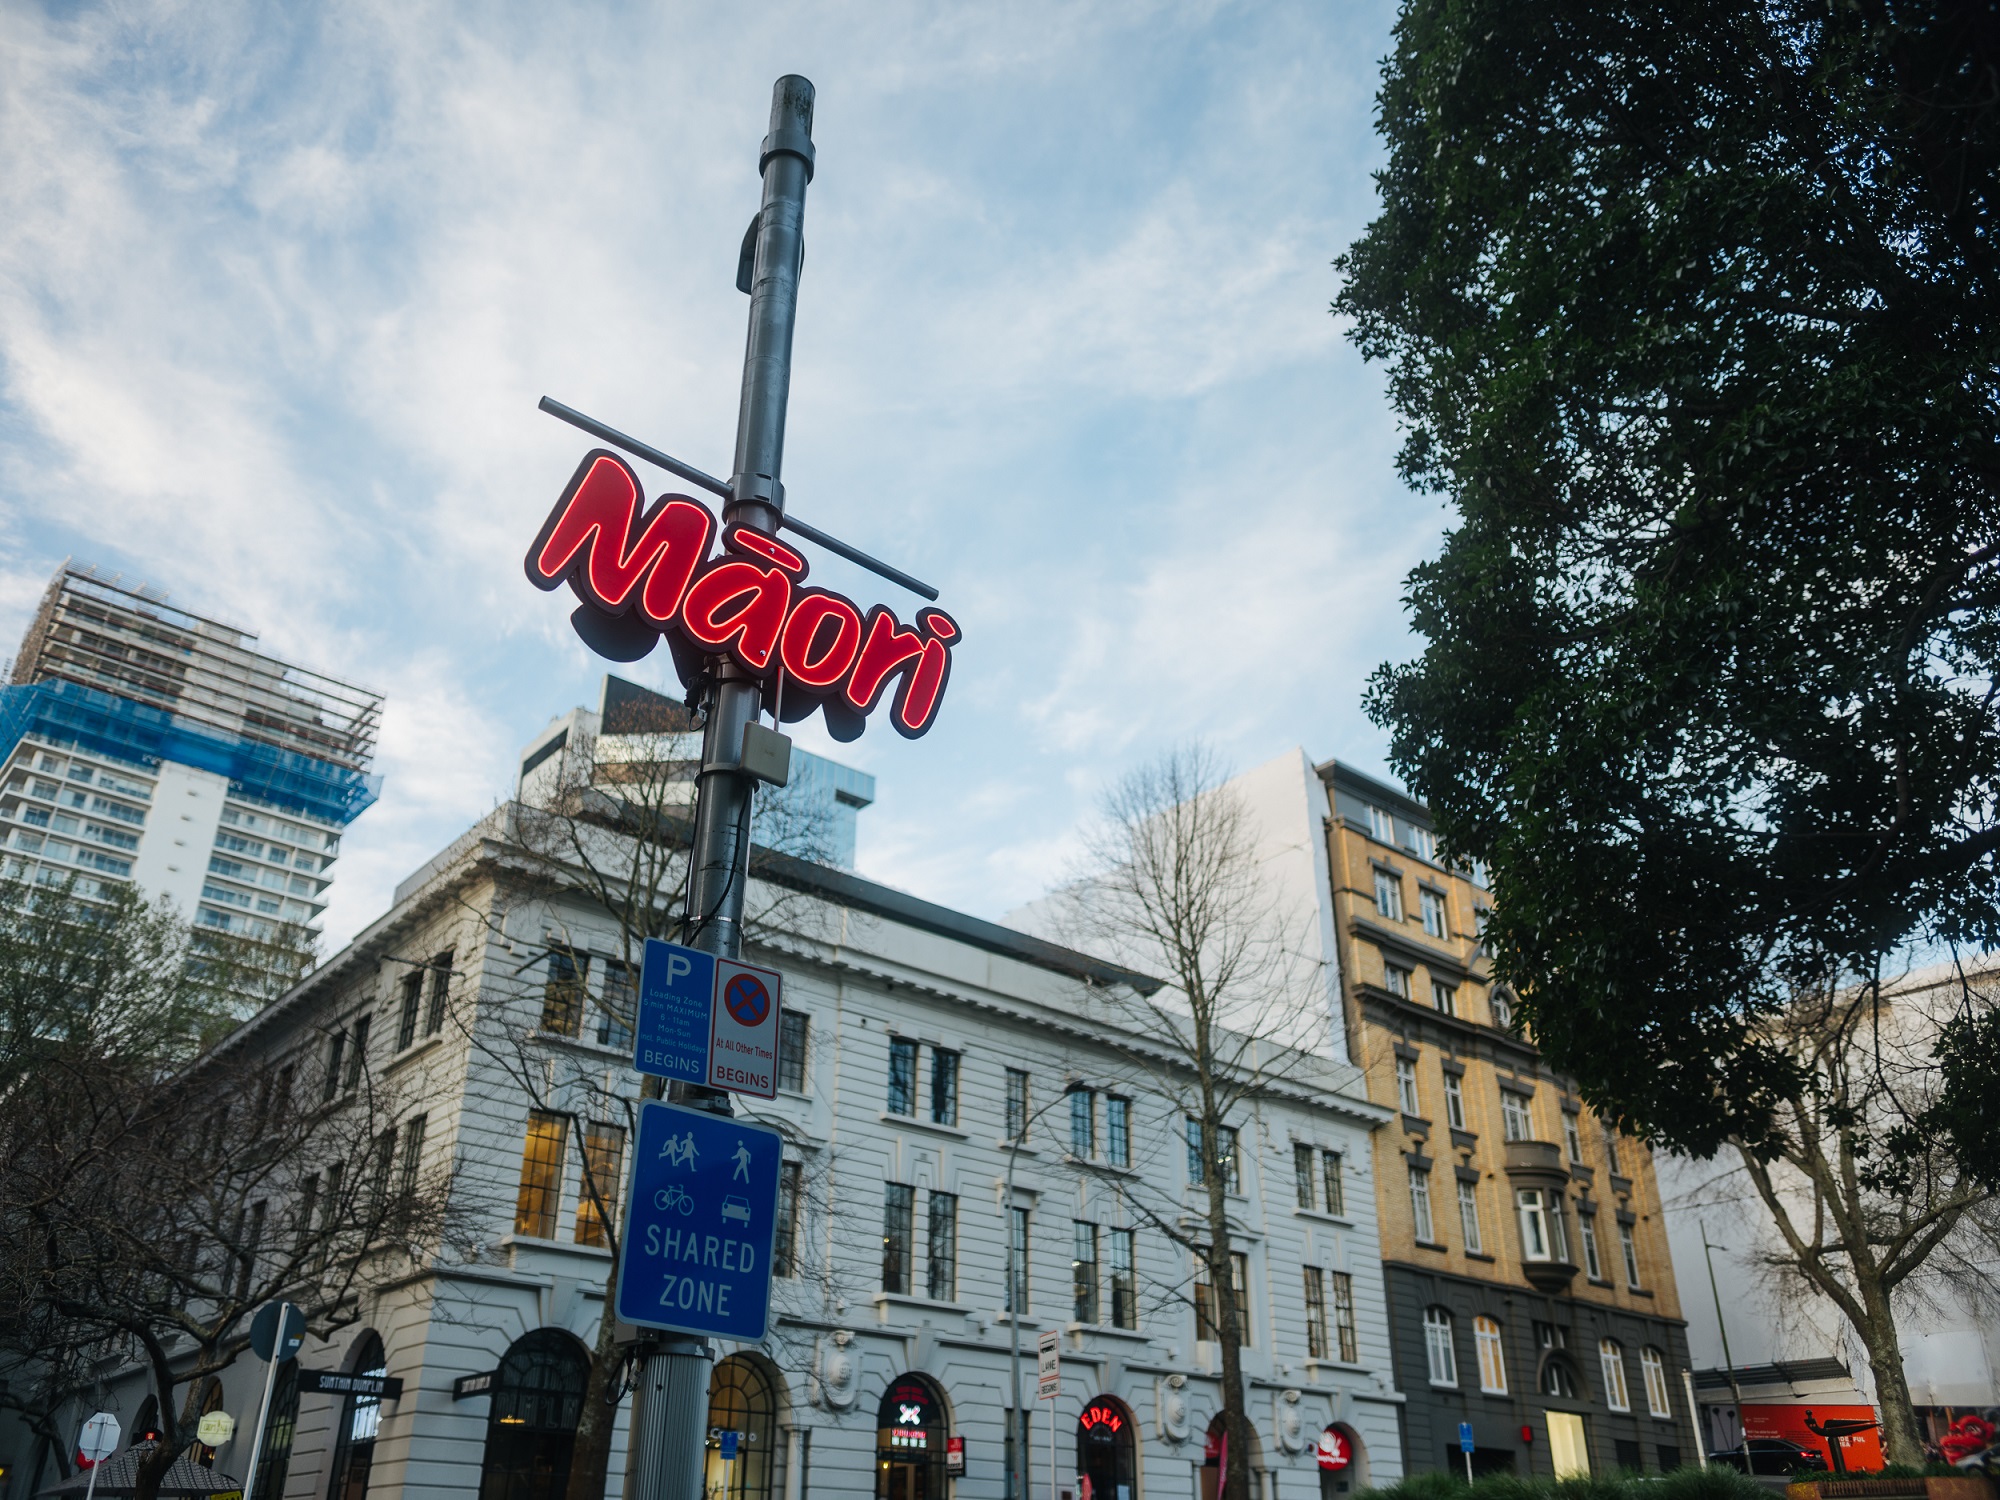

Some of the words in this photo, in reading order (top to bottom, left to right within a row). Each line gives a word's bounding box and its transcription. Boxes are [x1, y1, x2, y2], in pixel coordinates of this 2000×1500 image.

[533, 454, 959, 732] Māori
[666, 953, 692, 987] P
[643, 998, 649, 1006] 5
[650, 1001, 664, 1009] min
[667, 1004, 708, 1020] MAXIMUM
[649, 988, 681, 1004] Loading
[684, 996, 703, 1008] Zone
[658, 1024, 691, 1038] Mon-Sun
[673, 1016, 690, 1027] 11am
[656, 1036, 677, 1047] Public
[678, 1041, 706, 1054] Holidays
[716, 1037, 724, 1048] At
[725, 1040, 735, 1051] All
[736, 1042, 754, 1055] Other
[755, 1046, 773, 1060] Times
[644, 1049, 700, 1074] BEGINS
[716, 1065, 769, 1089] BEGINS
[644, 1224, 755, 1273] SHARED
[660, 1274, 732, 1317] ZONE
[1080, 1406, 1122, 1433] EDEN
